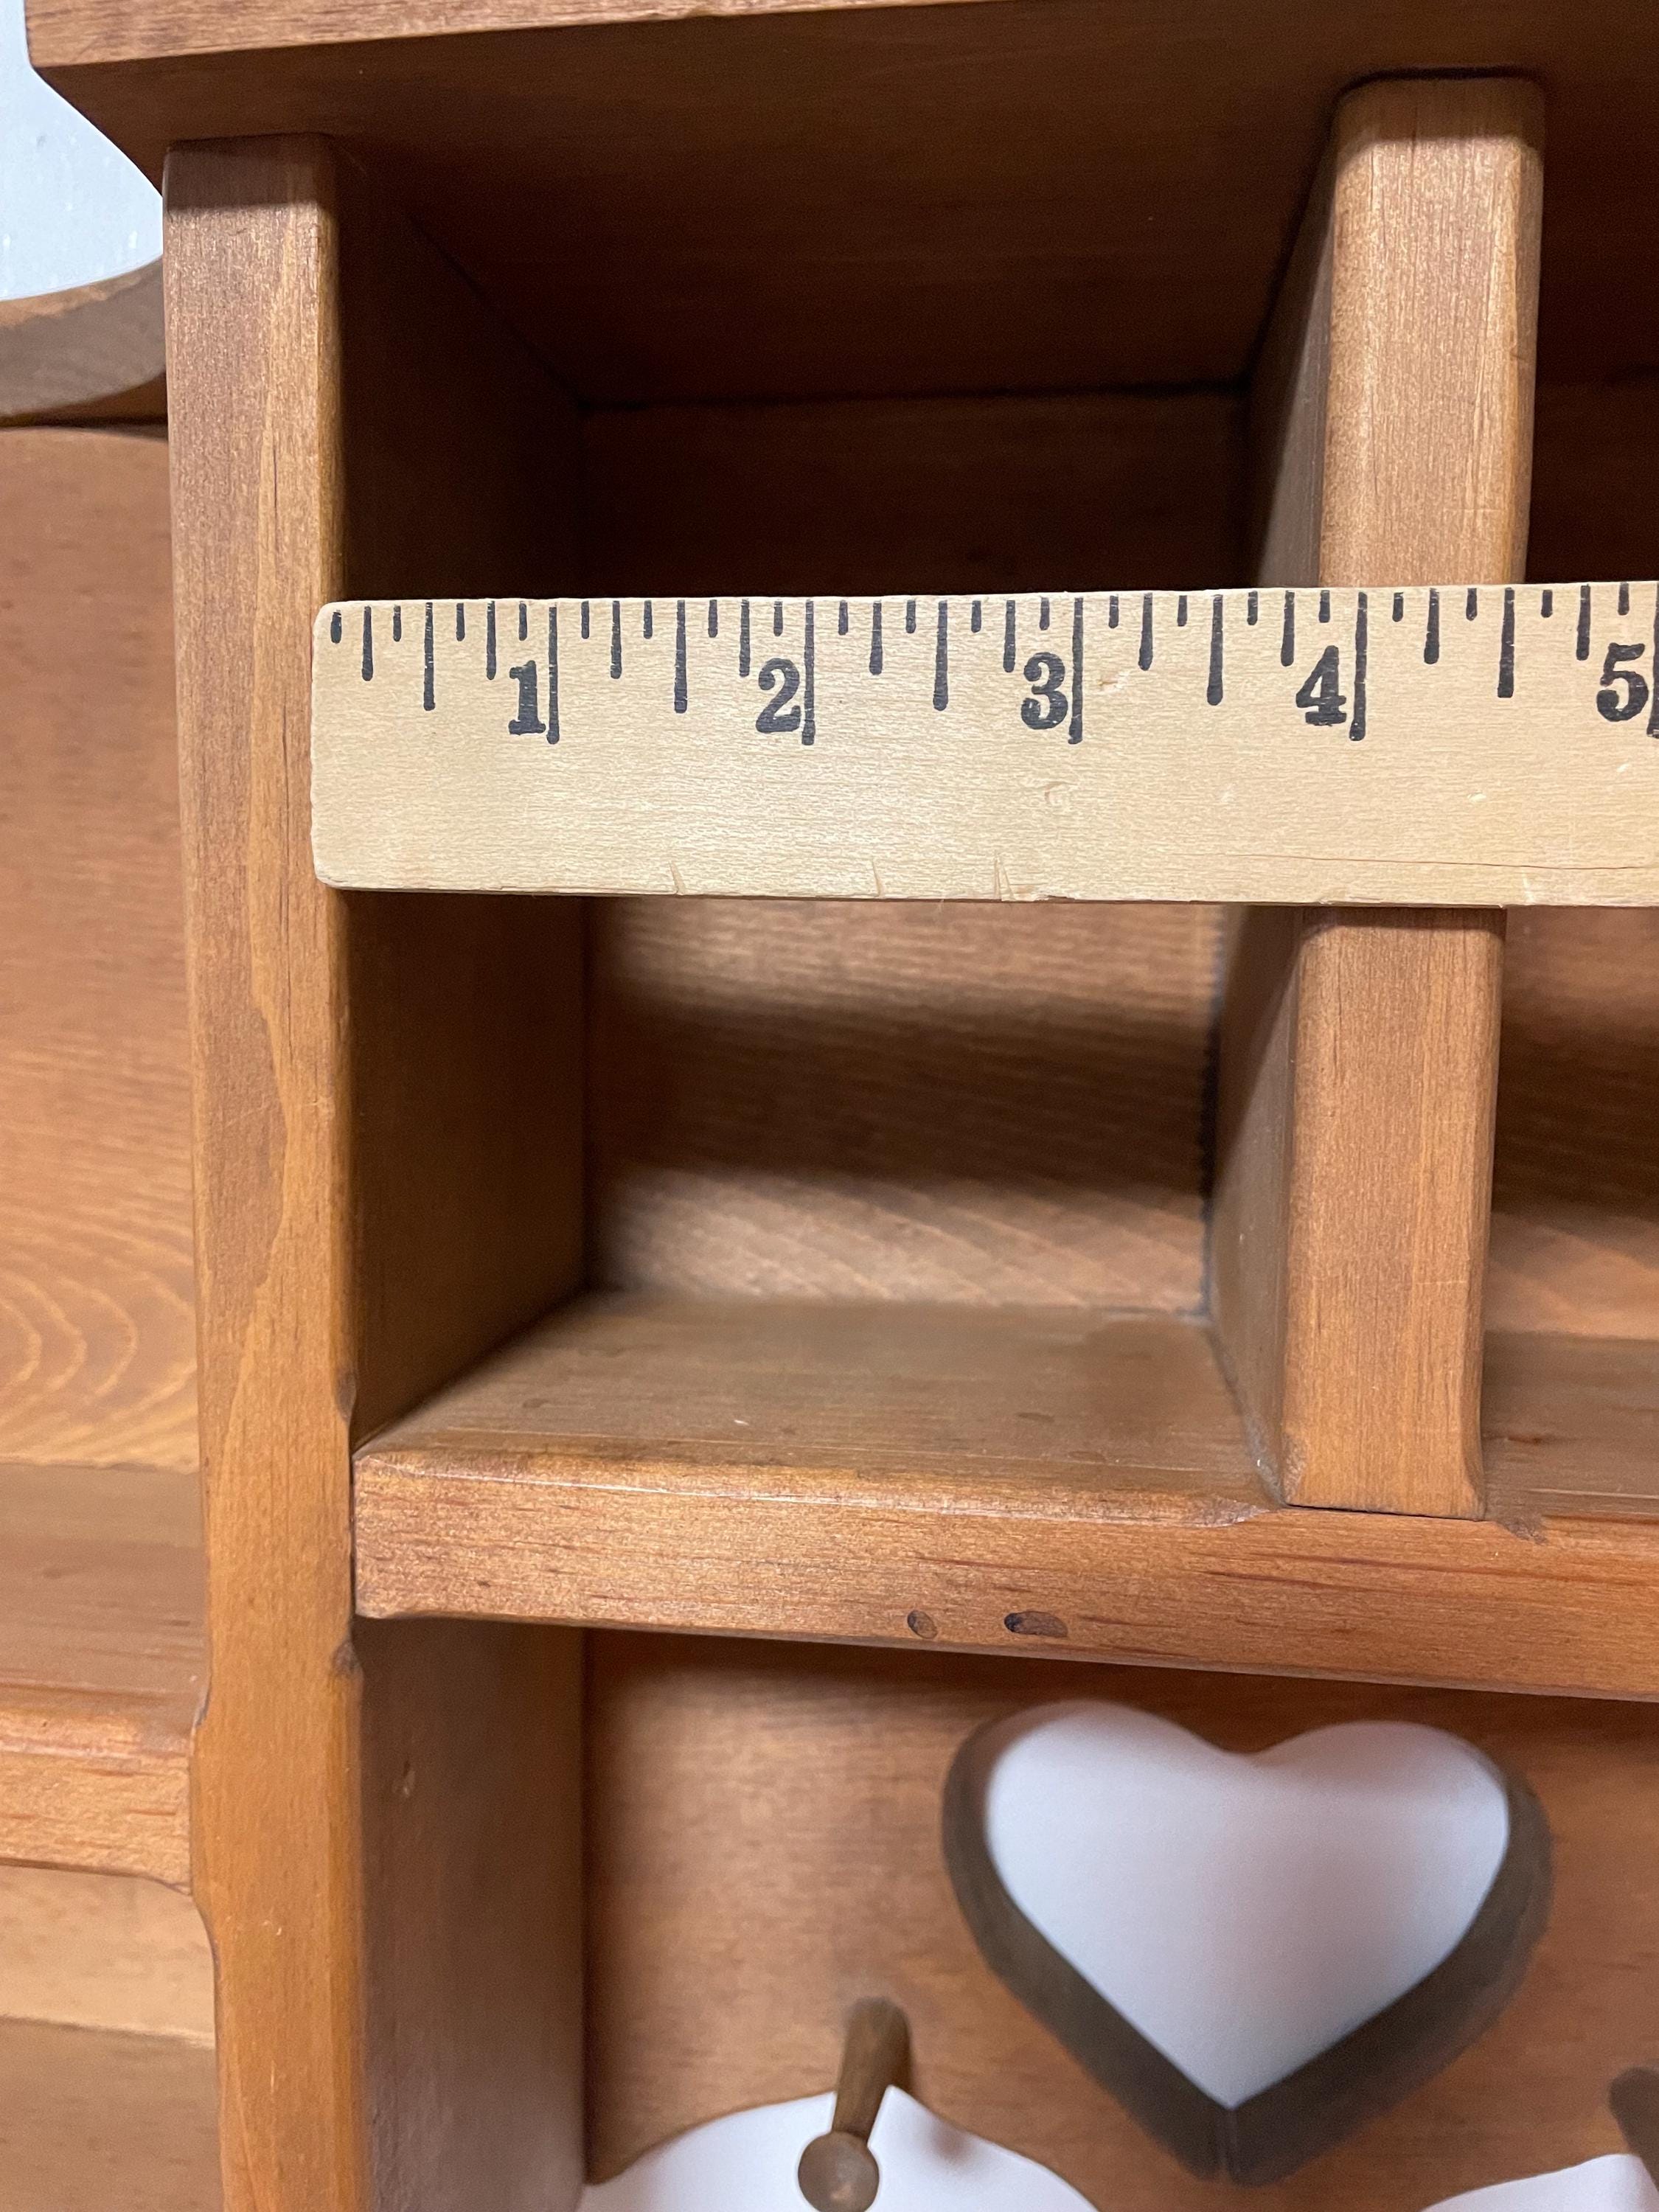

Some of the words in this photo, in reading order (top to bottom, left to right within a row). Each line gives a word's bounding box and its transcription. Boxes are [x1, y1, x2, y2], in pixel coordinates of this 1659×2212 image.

[507, 660, 546, 736] 1
[755, 658, 801, 734] 2
[1020, 652, 1068, 730] 3
[1295, 645, 1348, 727] 4
[1596, 642, 1649, 723] 5
